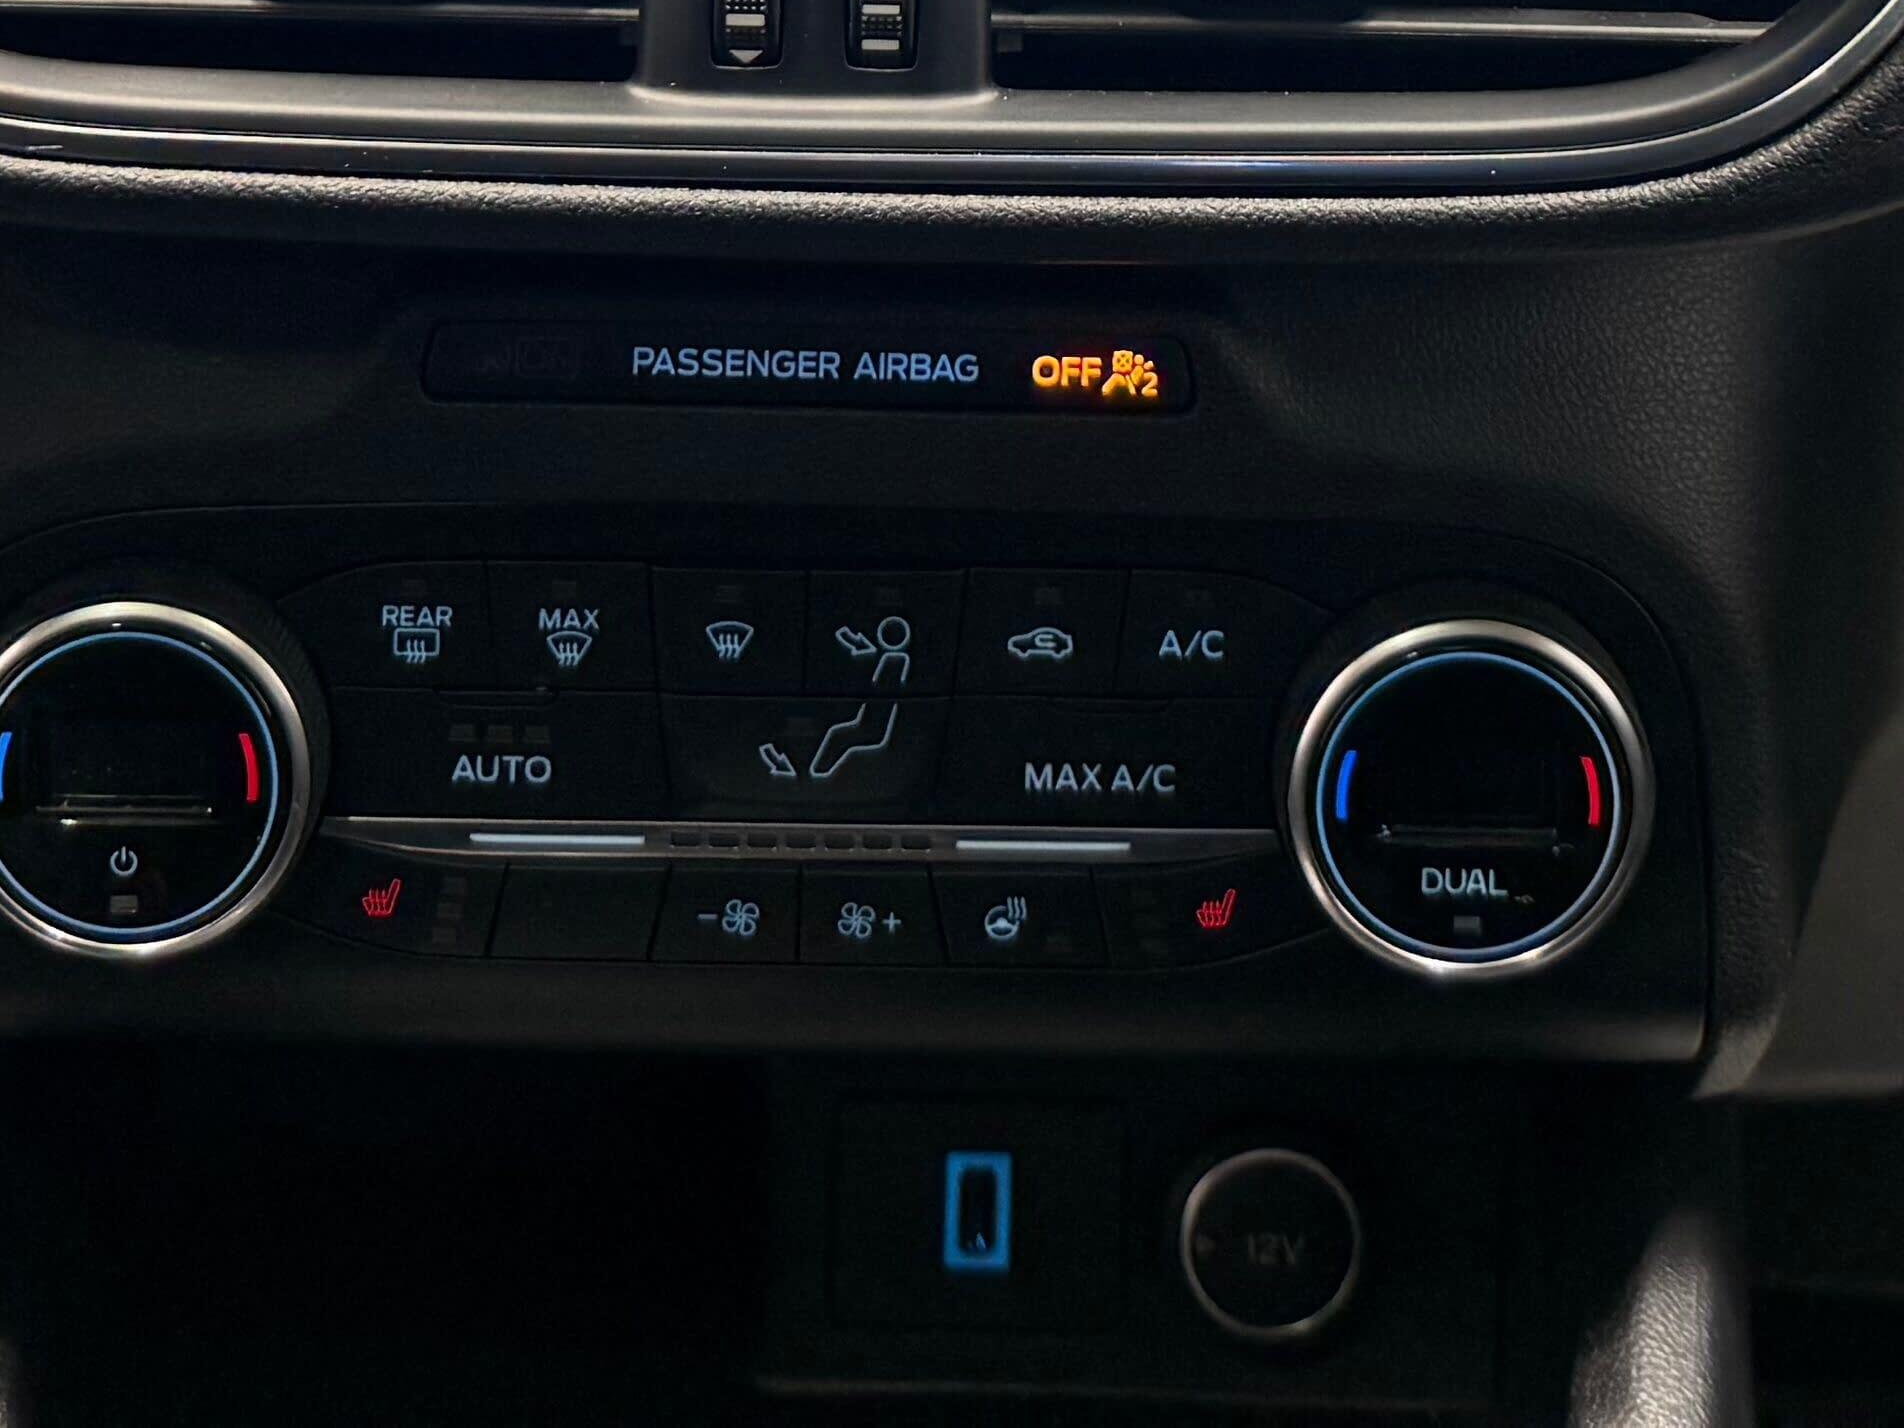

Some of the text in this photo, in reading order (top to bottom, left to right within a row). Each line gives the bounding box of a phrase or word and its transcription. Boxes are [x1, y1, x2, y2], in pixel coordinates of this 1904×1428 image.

[632, 345, 1103, 388] PASSENGER AIRBAG OFF
[382, 605, 454, 628] REAR
[539, 608, 600, 631] MAX
[1158, 629, 1226, 661] A/C
[452, 756, 553, 785] AUTO
[1024, 763, 1176, 794] MAX A/C
[1421, 867, 1508, 898] DUAL
